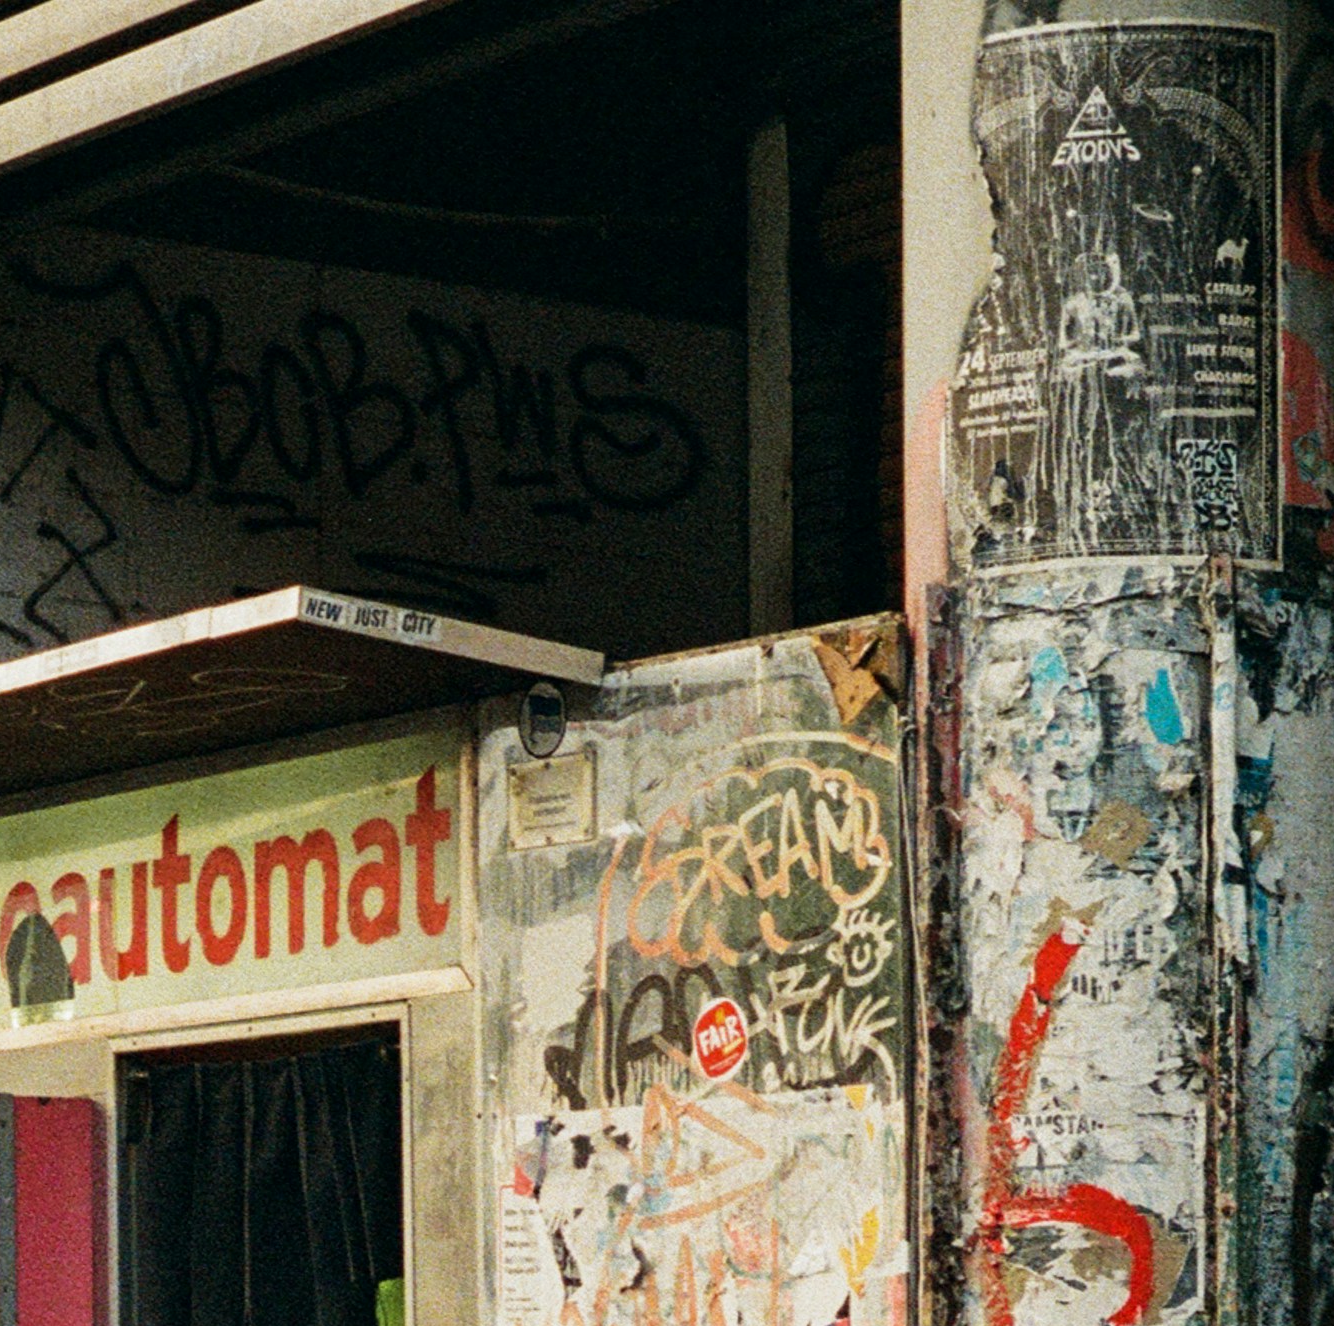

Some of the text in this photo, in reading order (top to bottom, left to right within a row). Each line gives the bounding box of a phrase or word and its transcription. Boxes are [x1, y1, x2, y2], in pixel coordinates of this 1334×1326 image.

[305, 597, 437, 635] NEW JUST CITY
[698, 1012, 739, 1050] FAIR
